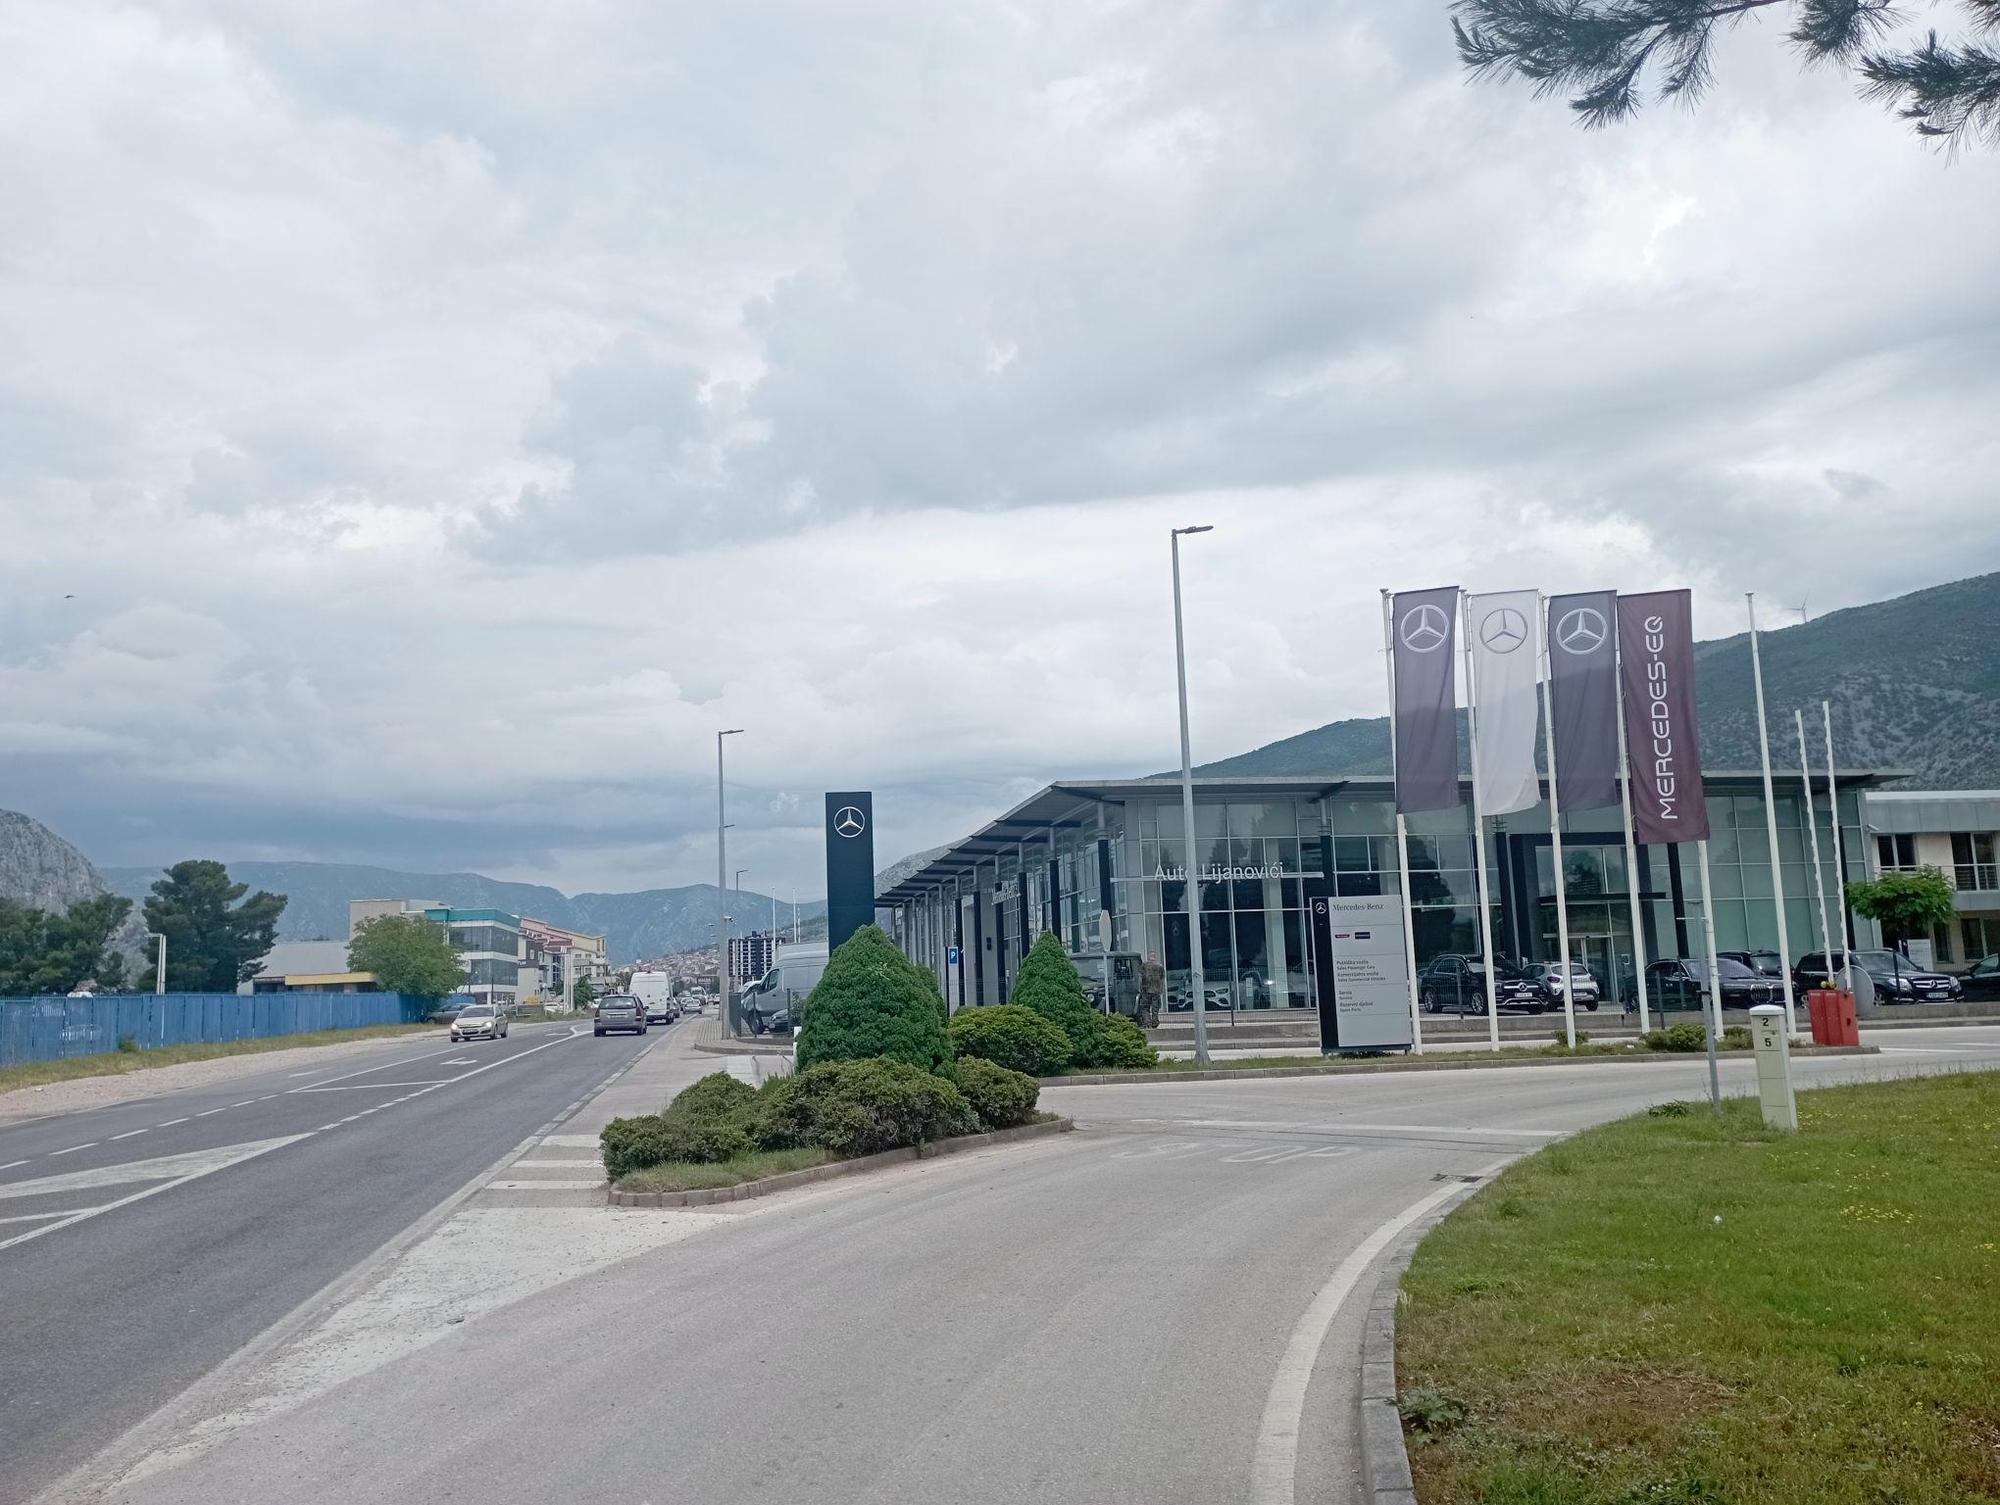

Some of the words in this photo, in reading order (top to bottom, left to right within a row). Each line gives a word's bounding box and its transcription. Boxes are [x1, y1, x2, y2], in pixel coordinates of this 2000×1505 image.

[1644, 615, 1678, 820] MERCEDES-EQ
[1201, 861, 1284, 884] Lijanovići
[1762, 1017, 1769, 1027] 2
[1764, 1037, 1772, 1047] 5
